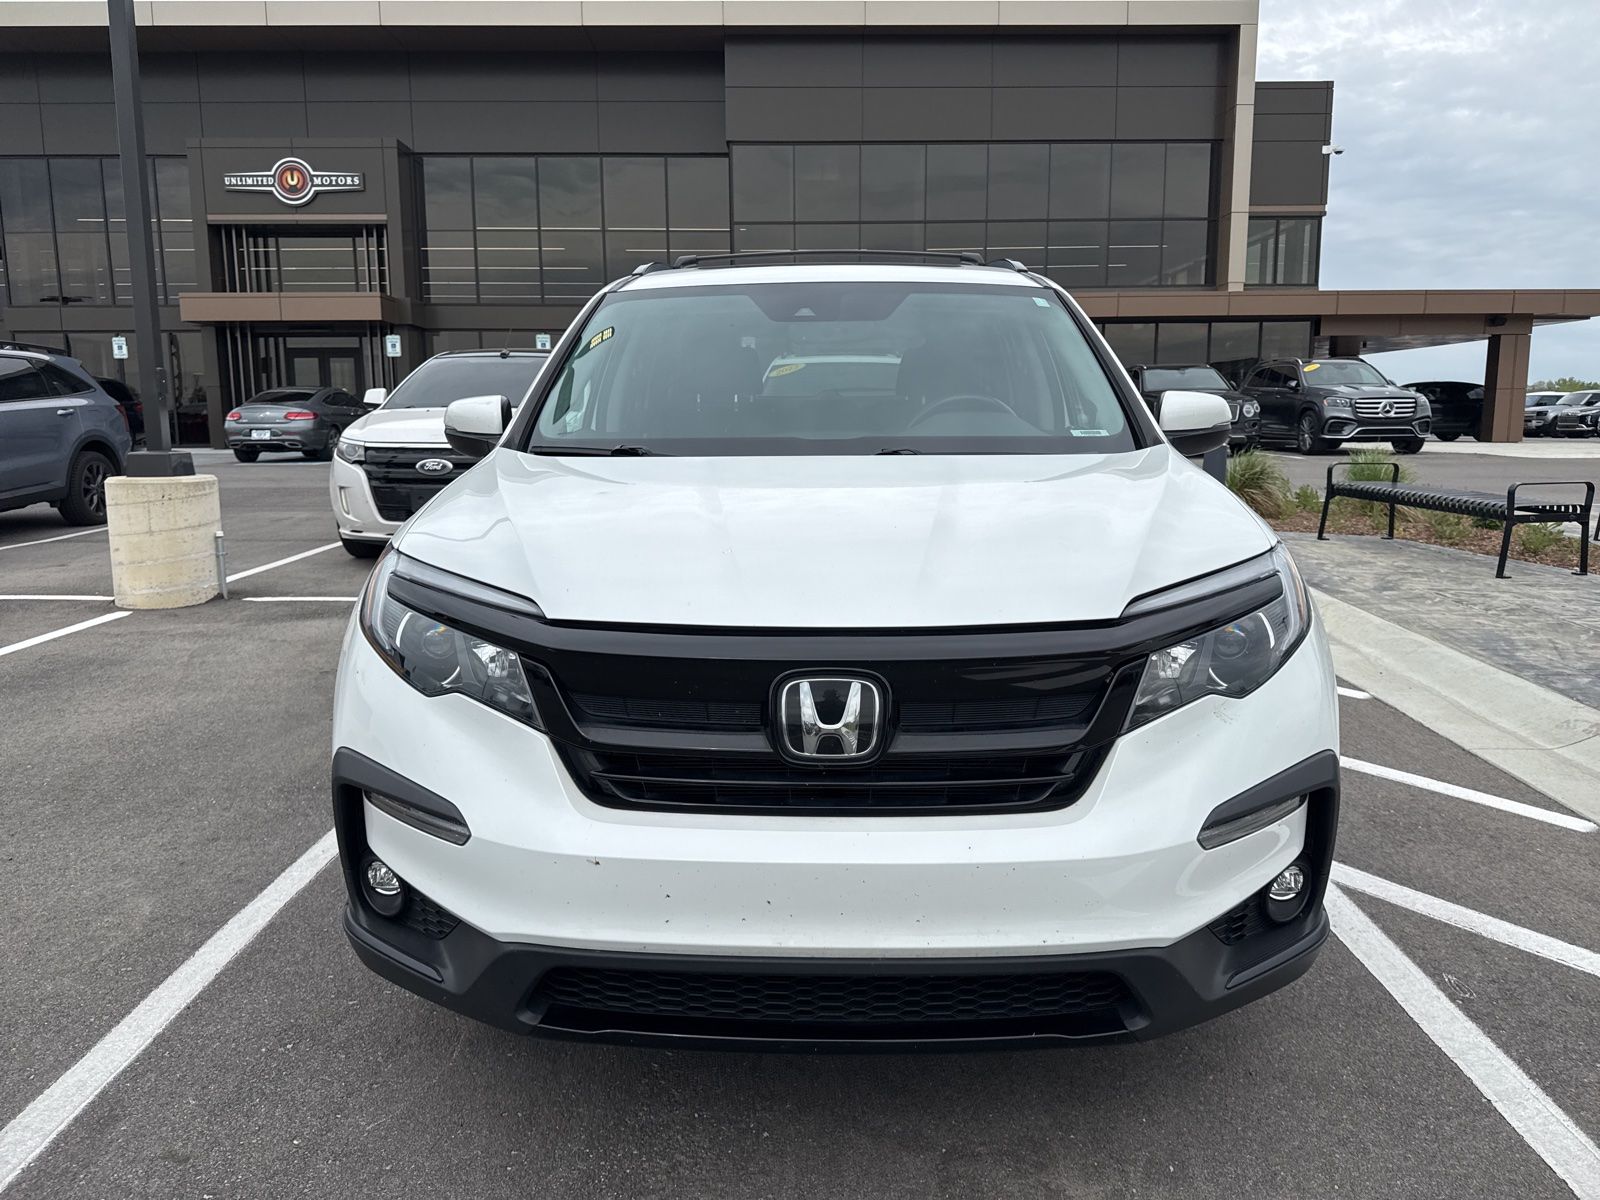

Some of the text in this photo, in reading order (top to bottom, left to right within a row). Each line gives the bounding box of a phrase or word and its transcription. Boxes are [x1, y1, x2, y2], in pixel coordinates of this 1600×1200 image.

[224, 176, 360, 185] UNLIMITED MOTORS
[424, 461, 443, 470] Ford
